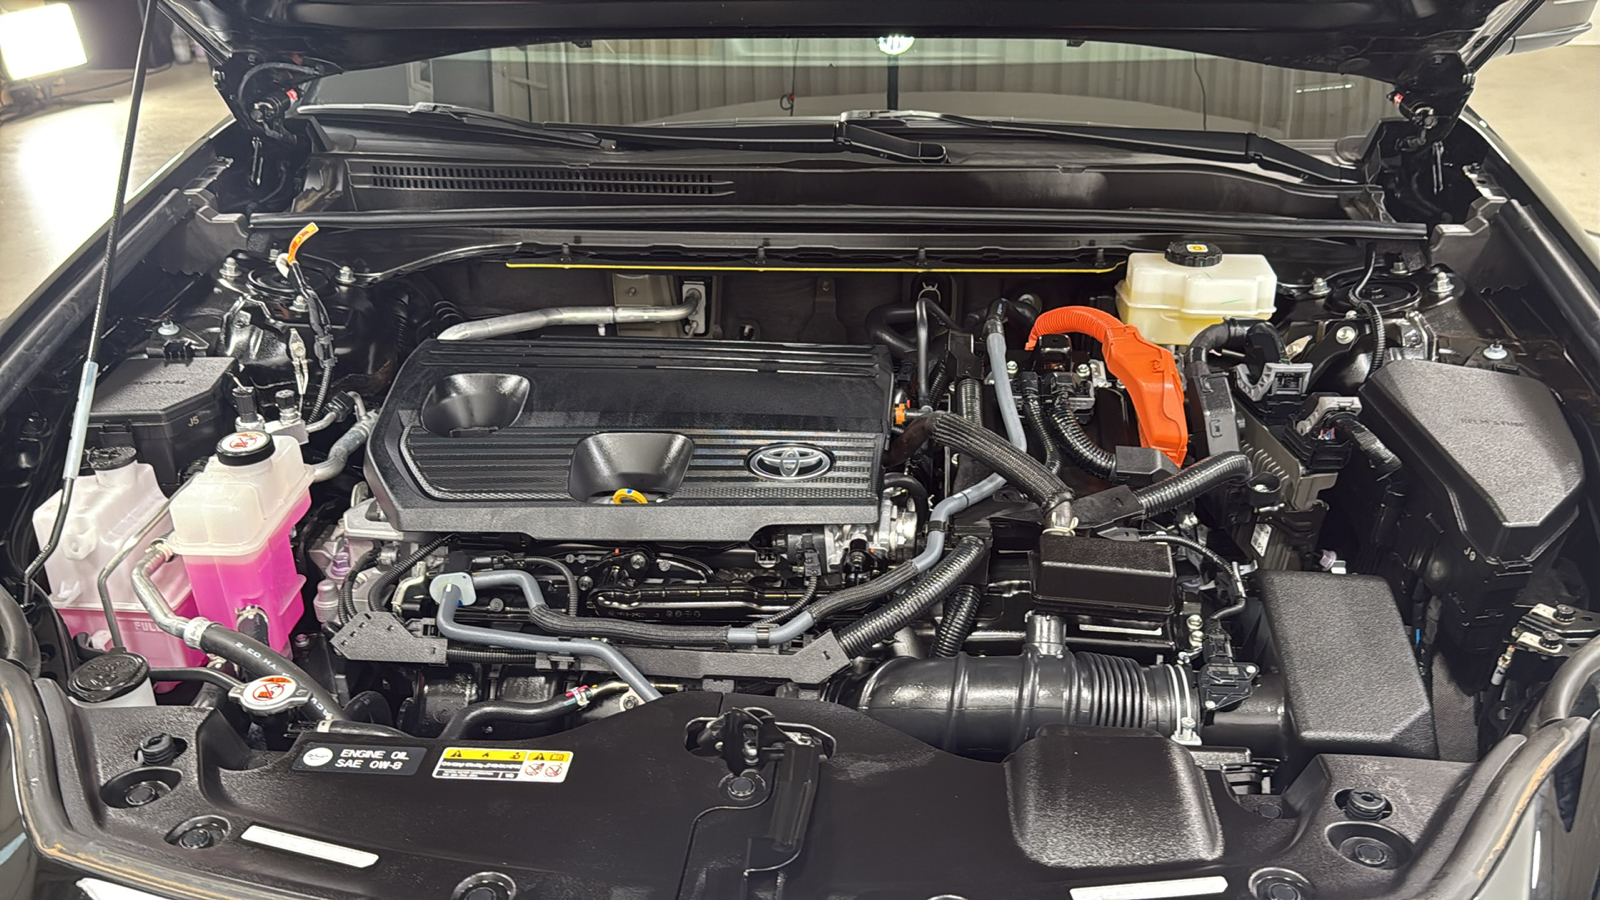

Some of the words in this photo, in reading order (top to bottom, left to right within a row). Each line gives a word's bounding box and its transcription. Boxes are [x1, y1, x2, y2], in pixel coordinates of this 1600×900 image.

[188, 415, 200, 427] J5
[340, 748, 386, 759] ENGINE
[391, 751, 410, 760] OIL
[335, 759, 364, 768] SAE
[369, 760, 403, 770] 0W-8
